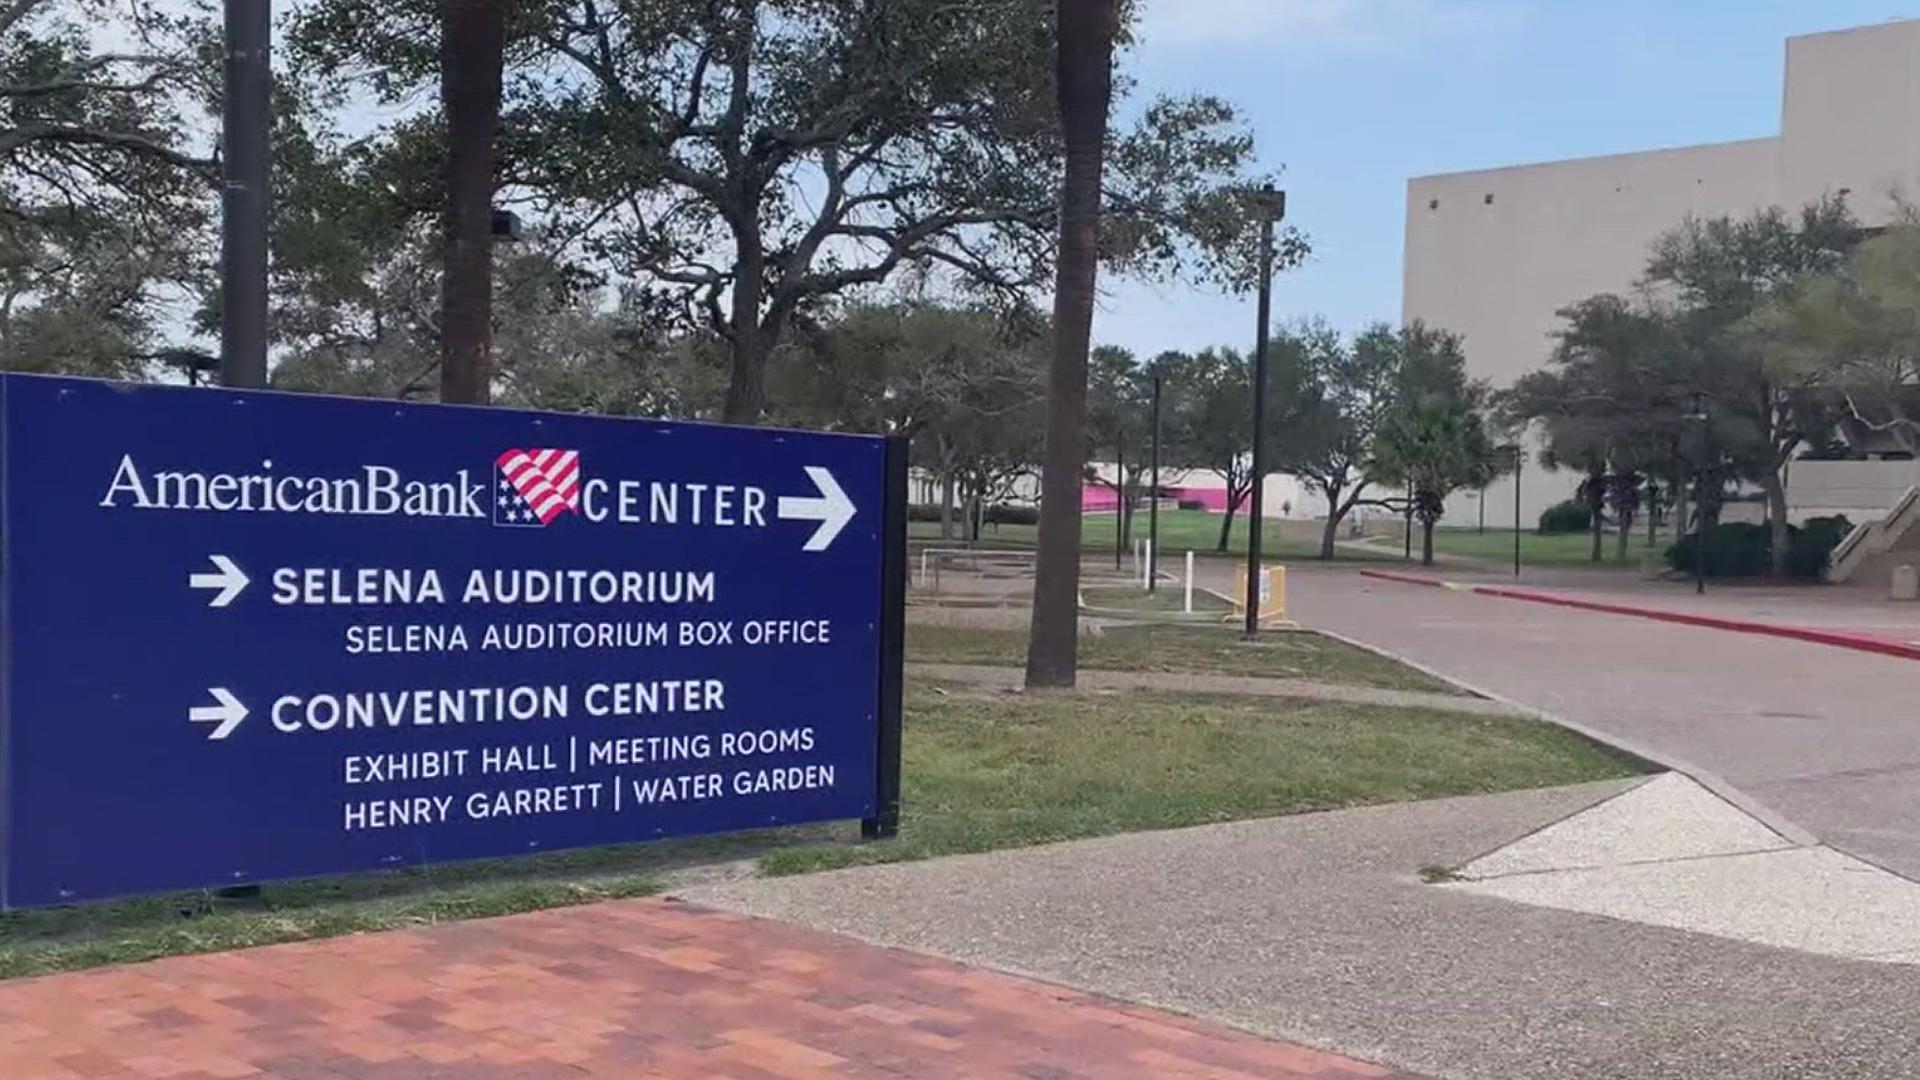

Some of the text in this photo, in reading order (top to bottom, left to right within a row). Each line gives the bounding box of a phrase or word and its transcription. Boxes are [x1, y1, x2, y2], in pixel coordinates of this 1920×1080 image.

[99, 454, 768, 527] AmericanBank CENTER
[272, 566, 715, 606] SELENA AUDITORIUM
[345, 619, 831, 654] SELENA AUDITORIUM BOX OFFICE
[270, 679, 726, 733] CONVENTION CENTER
[344, 726, 816, 785] EXHIBIT HALL MEETING ROOMS
[343, 764, 836, 831] HENRY GARRETT WATER GARDEN
